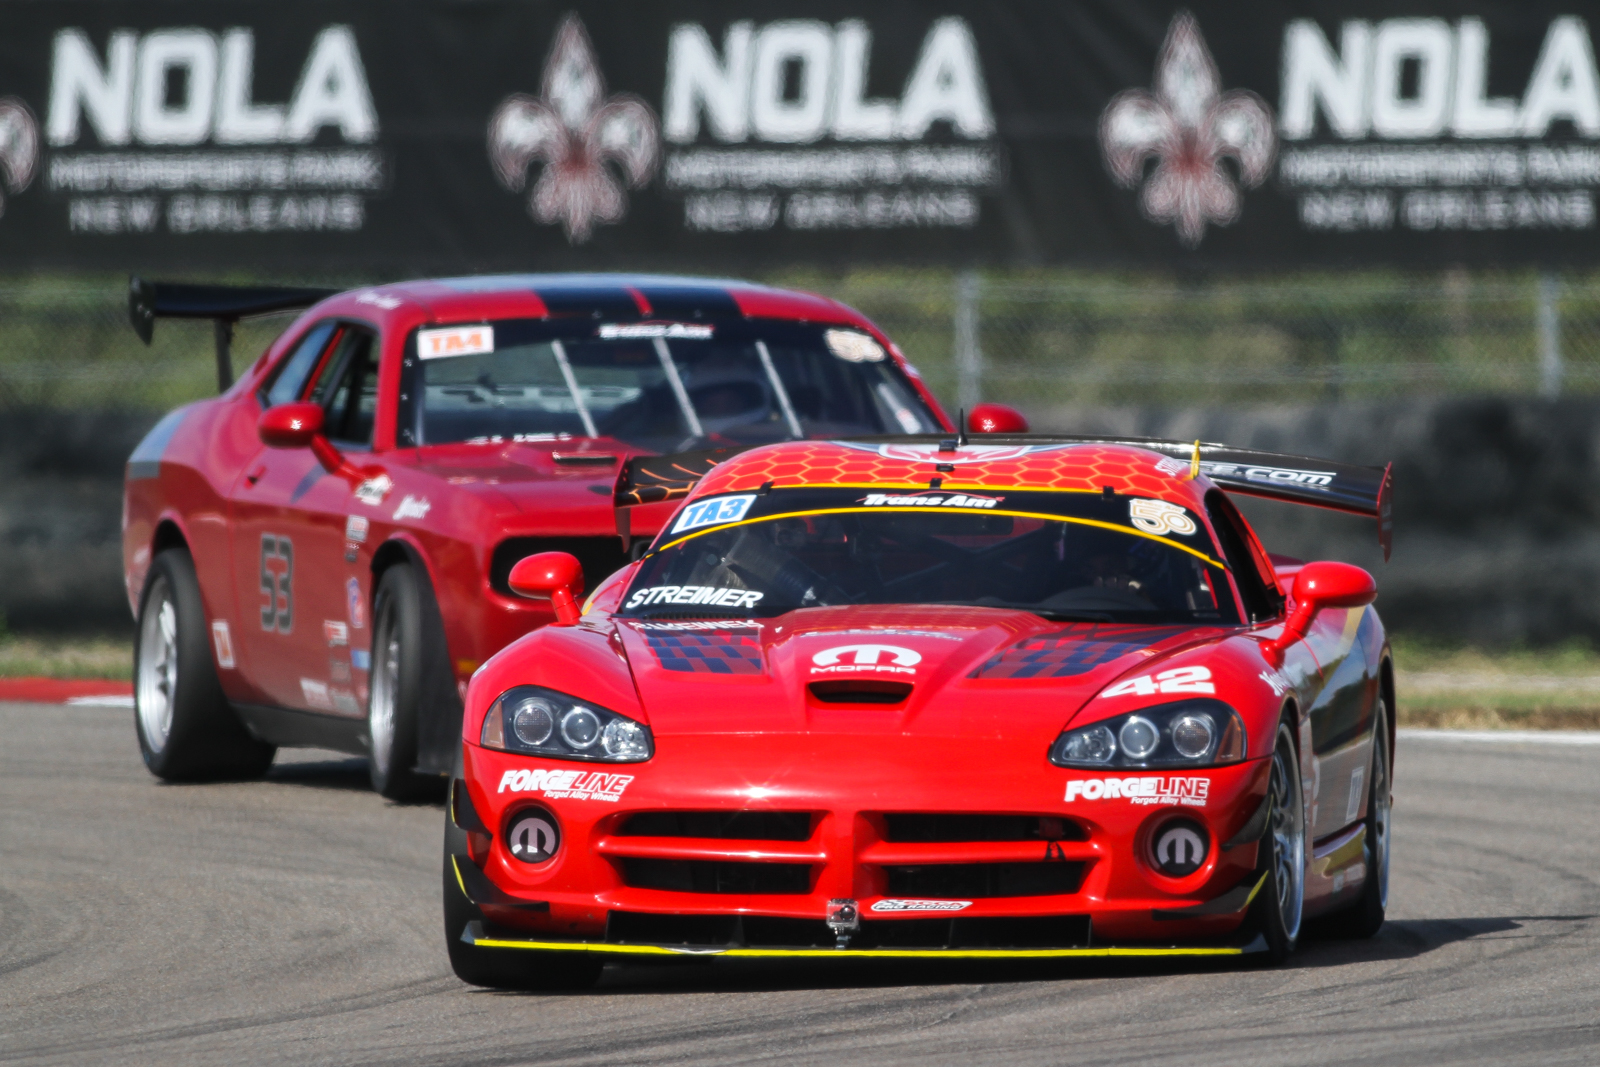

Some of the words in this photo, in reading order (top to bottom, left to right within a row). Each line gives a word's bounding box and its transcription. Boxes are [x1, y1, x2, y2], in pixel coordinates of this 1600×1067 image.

[47, 25, 379, 145] NOLA
[662, 16, 995, 144] NOLA
[1280, 16, 1600, 140] NOLA
[683, 498, 747, 527] TA3
[863, 494, 944, 505] Trans
[941, 495, 997, 508] Am
[1130, 501, 1197, 535] 50
[260, 532, 294, 634] 53
[626, 585, 764, 608] STREIMER
[810, 665, 916, 674] MOPAR
[1101, 666, 1216, 698] 42
[497, 769, 635, 795] FORGELINE
[1064, 777, 1210, 802] FORGELINE
[543, 789, 570, 800] Forged
[569, 790, 590, 801] Alloy
[590, 791, 620, 803] Wheels
[1131, 796, 1158, 806] Forged
[1159, 797, 1179, 806] Alloy
[1180, 797, 1207, 807] Wheels
